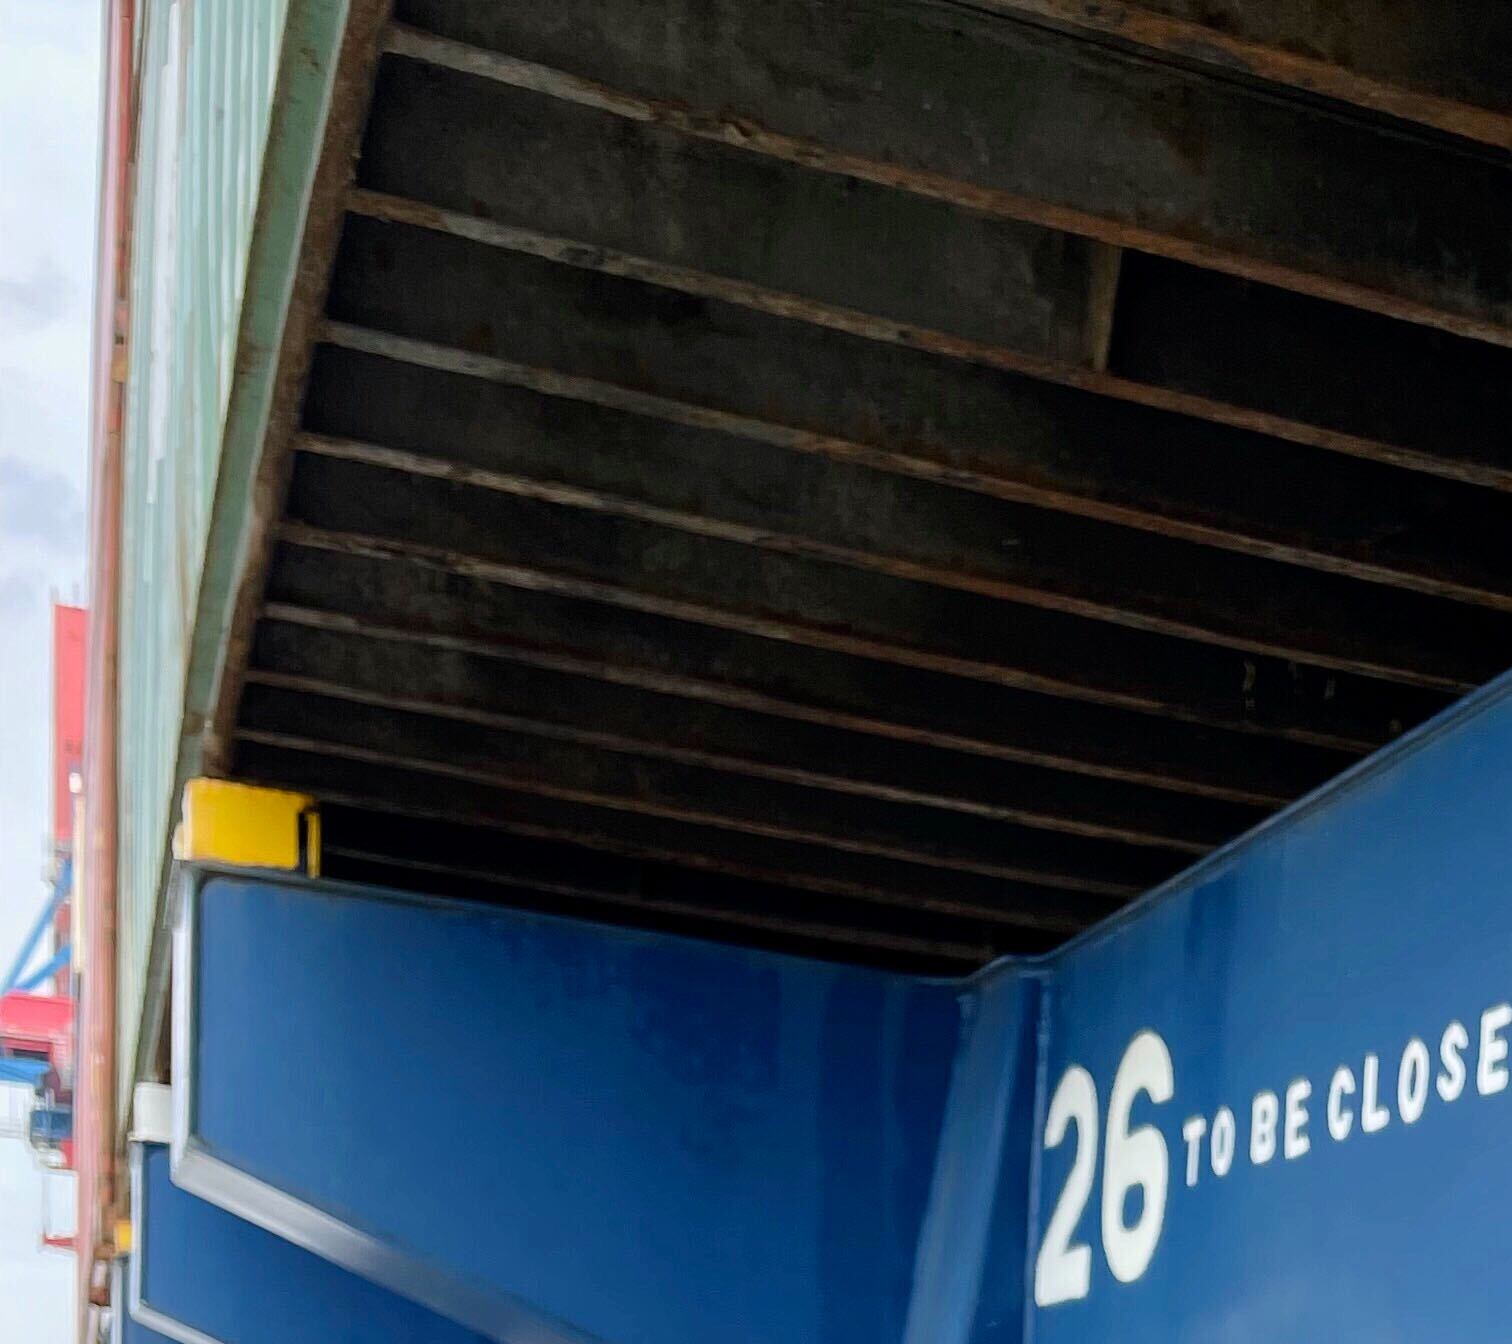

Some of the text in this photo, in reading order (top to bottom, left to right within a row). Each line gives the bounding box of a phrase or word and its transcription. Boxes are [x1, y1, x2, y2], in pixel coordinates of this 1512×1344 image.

[1035, 1030, 1174, 1307] 26
[1183, 1105, 1236, 1187] TO
[1250, 1078, 1312, 1165] BE
